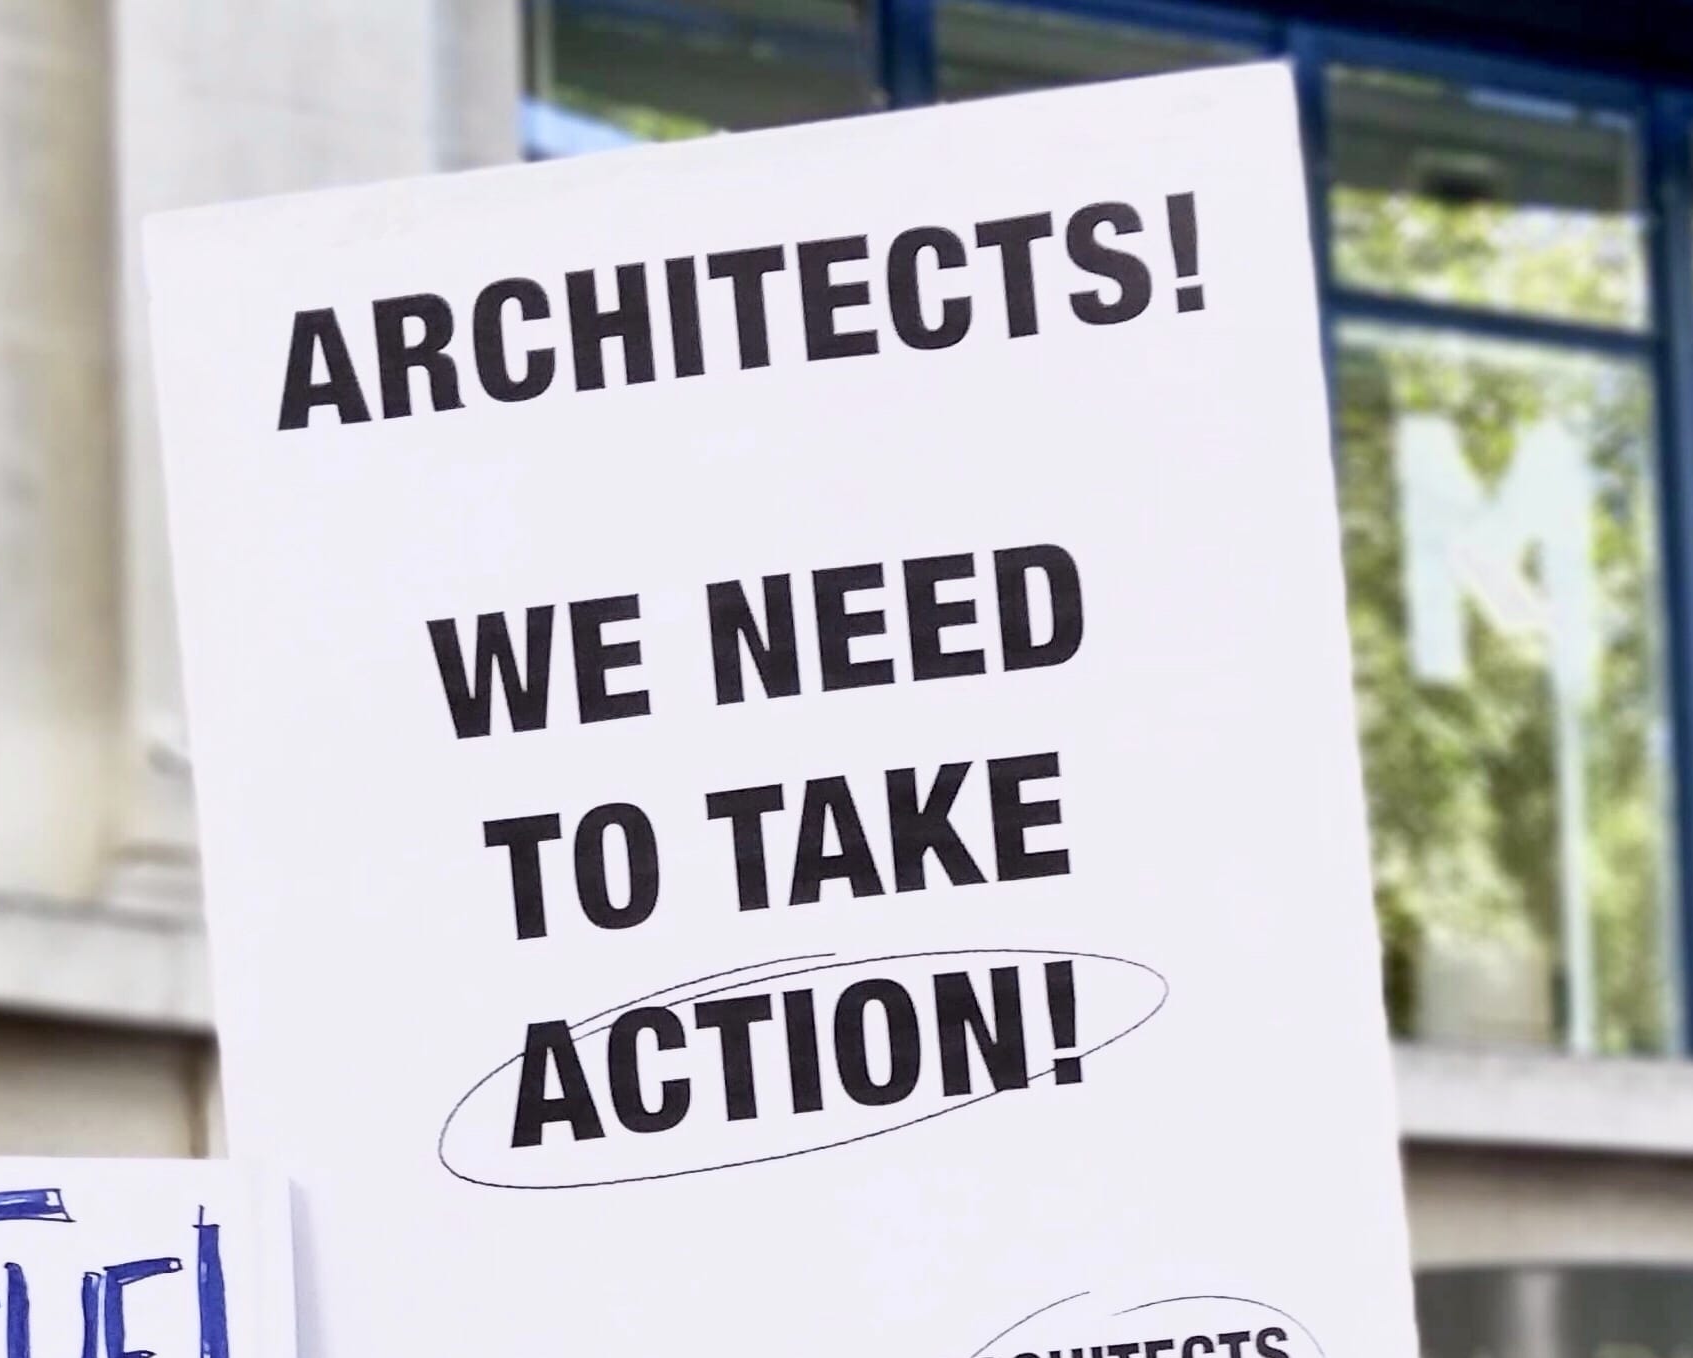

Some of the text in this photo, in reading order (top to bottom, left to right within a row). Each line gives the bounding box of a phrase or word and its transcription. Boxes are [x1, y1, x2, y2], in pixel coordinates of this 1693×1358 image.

[278, 193, 1206, 431] ARCHITECTS!
[426, 544, 1084, 740] WE NEED
[482, 751, 1071, 940] TO TAKE
[510, 959, 1083, 1149] ACTION!
